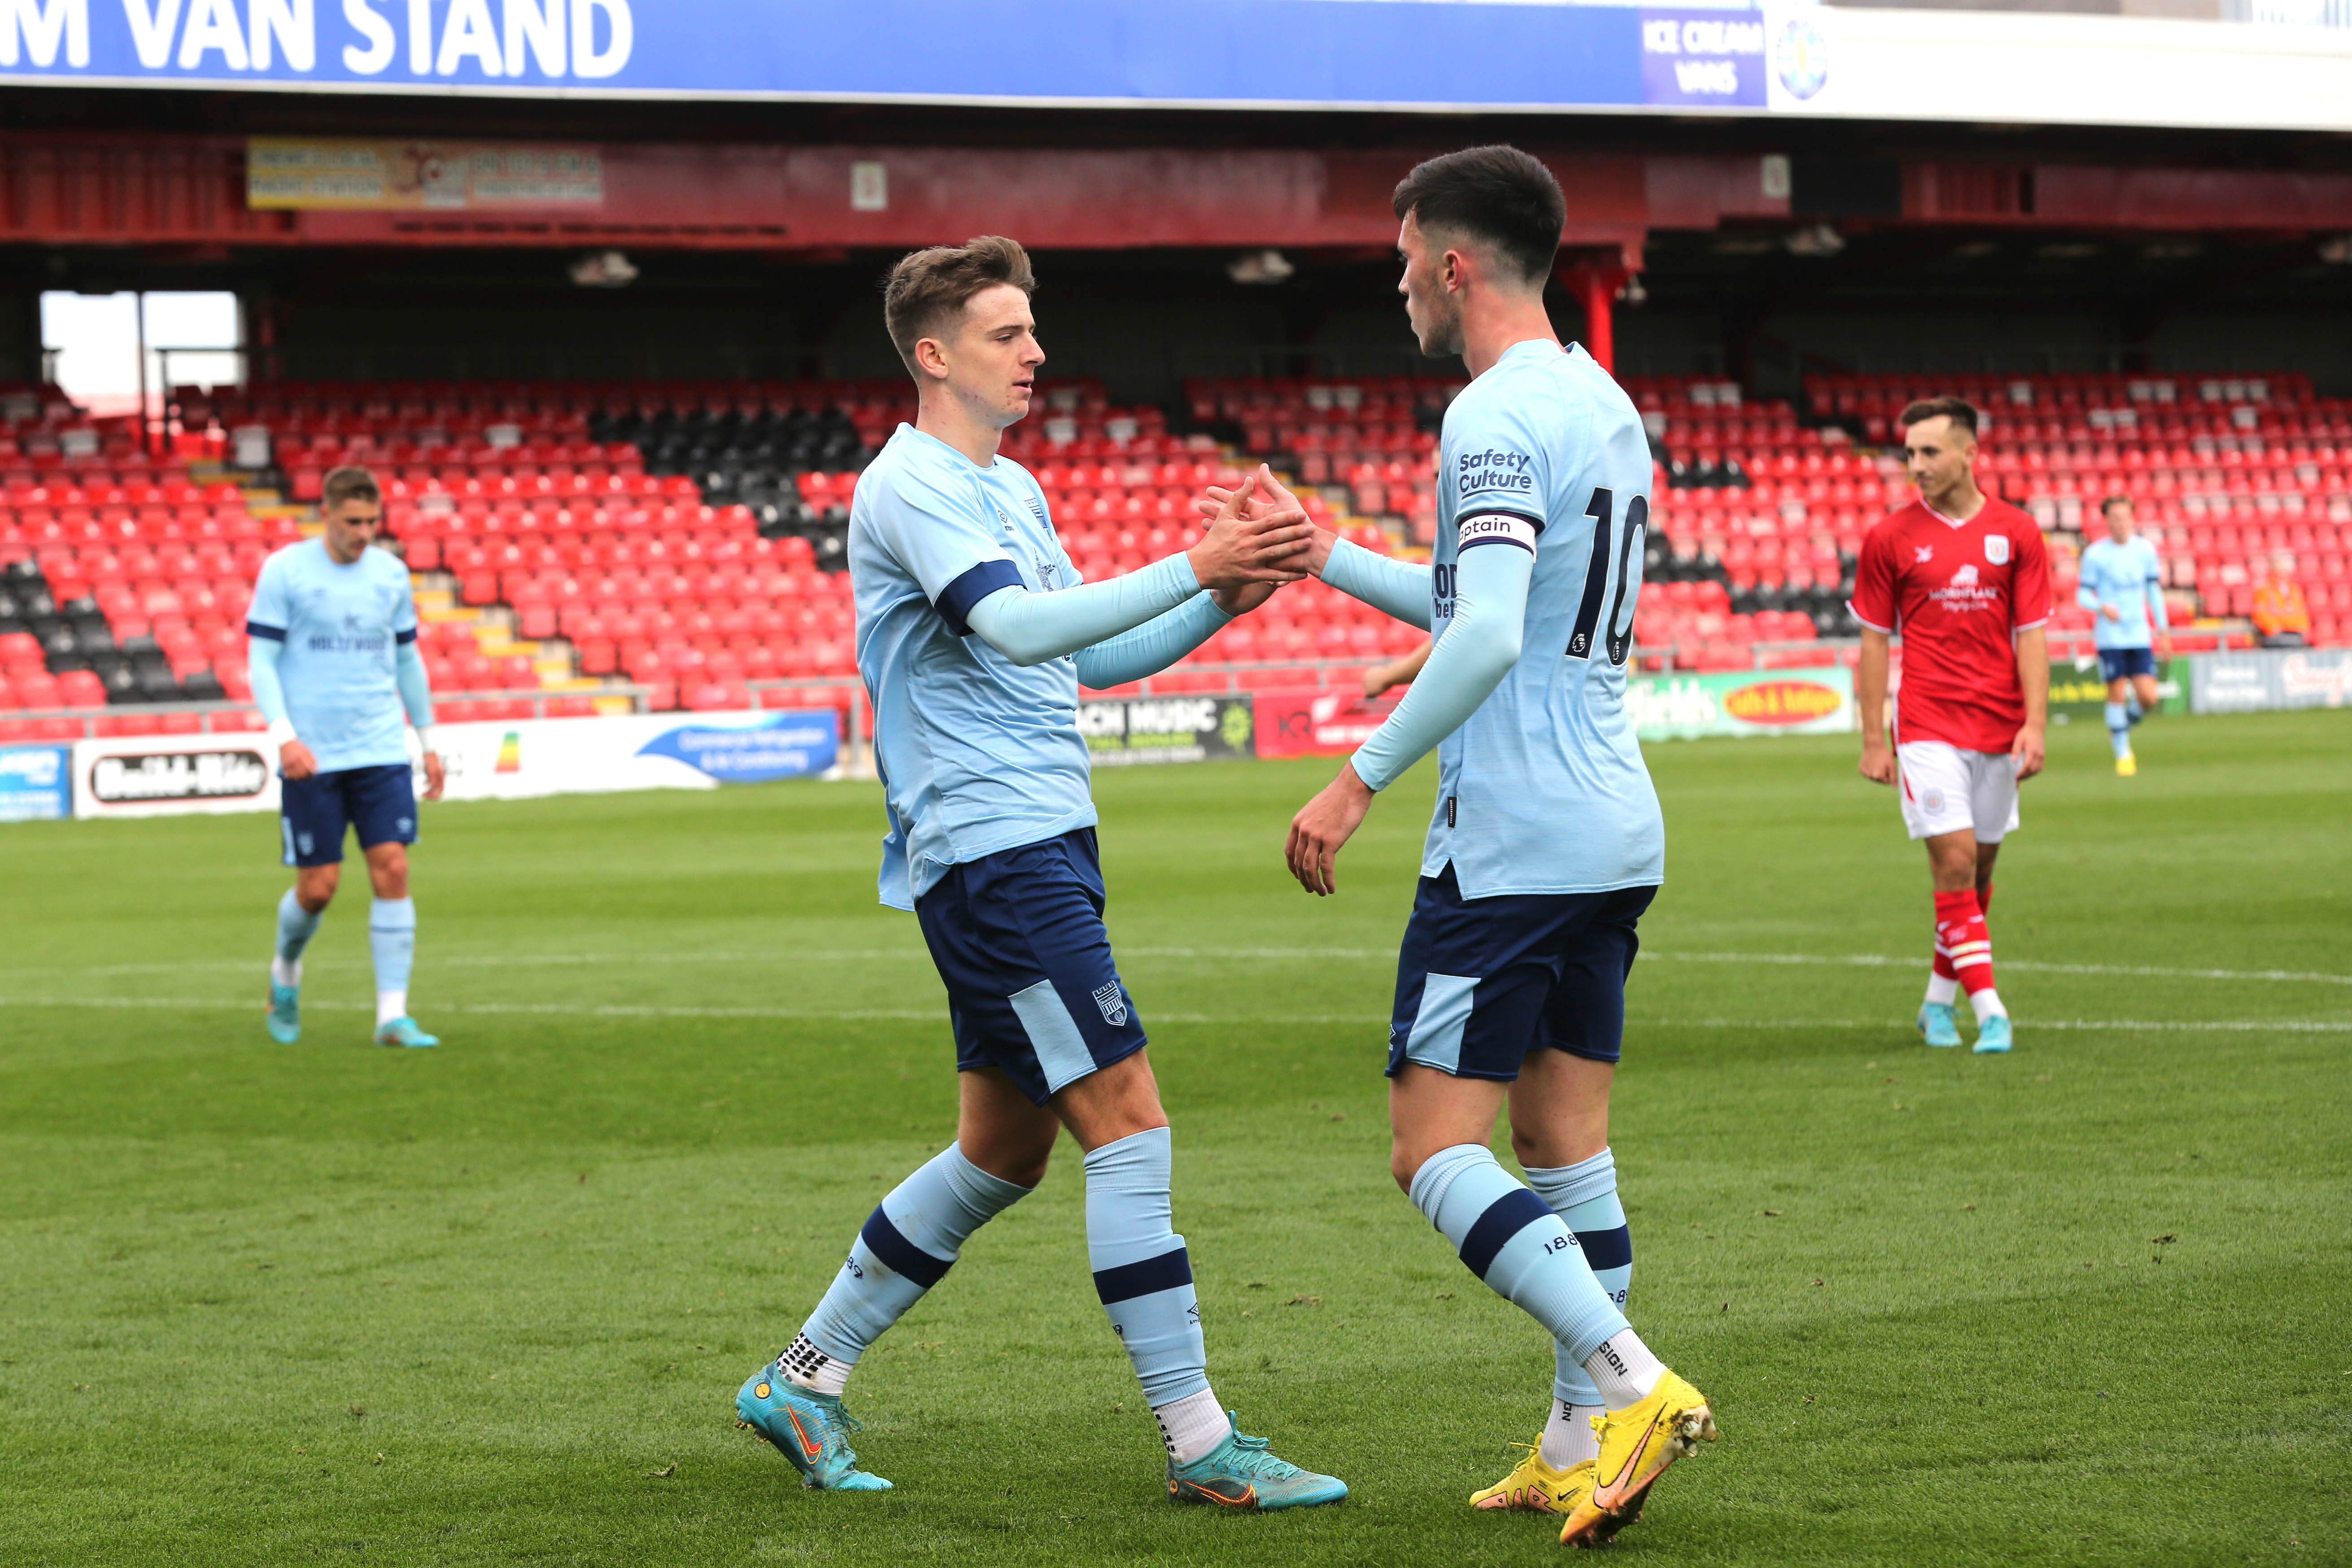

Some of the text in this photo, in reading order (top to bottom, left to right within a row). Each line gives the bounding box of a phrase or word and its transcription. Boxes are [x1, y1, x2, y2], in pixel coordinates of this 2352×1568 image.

[122, 0, 316, 72] VAN
[342, 0, 633, 79] STAND
[1643, 19, 1765, 54] ICE CREAM
[1675, 60, 1737, 95] VANS
[1460, 449, 1531, 473] Safety
[1460, 469, 1532, 493] Culture
[1564, 485, 1650, 667] 10
[1127, 698, 1218, 732] MUSIC
[1599, 1341, 1628, 1377] SIGN
